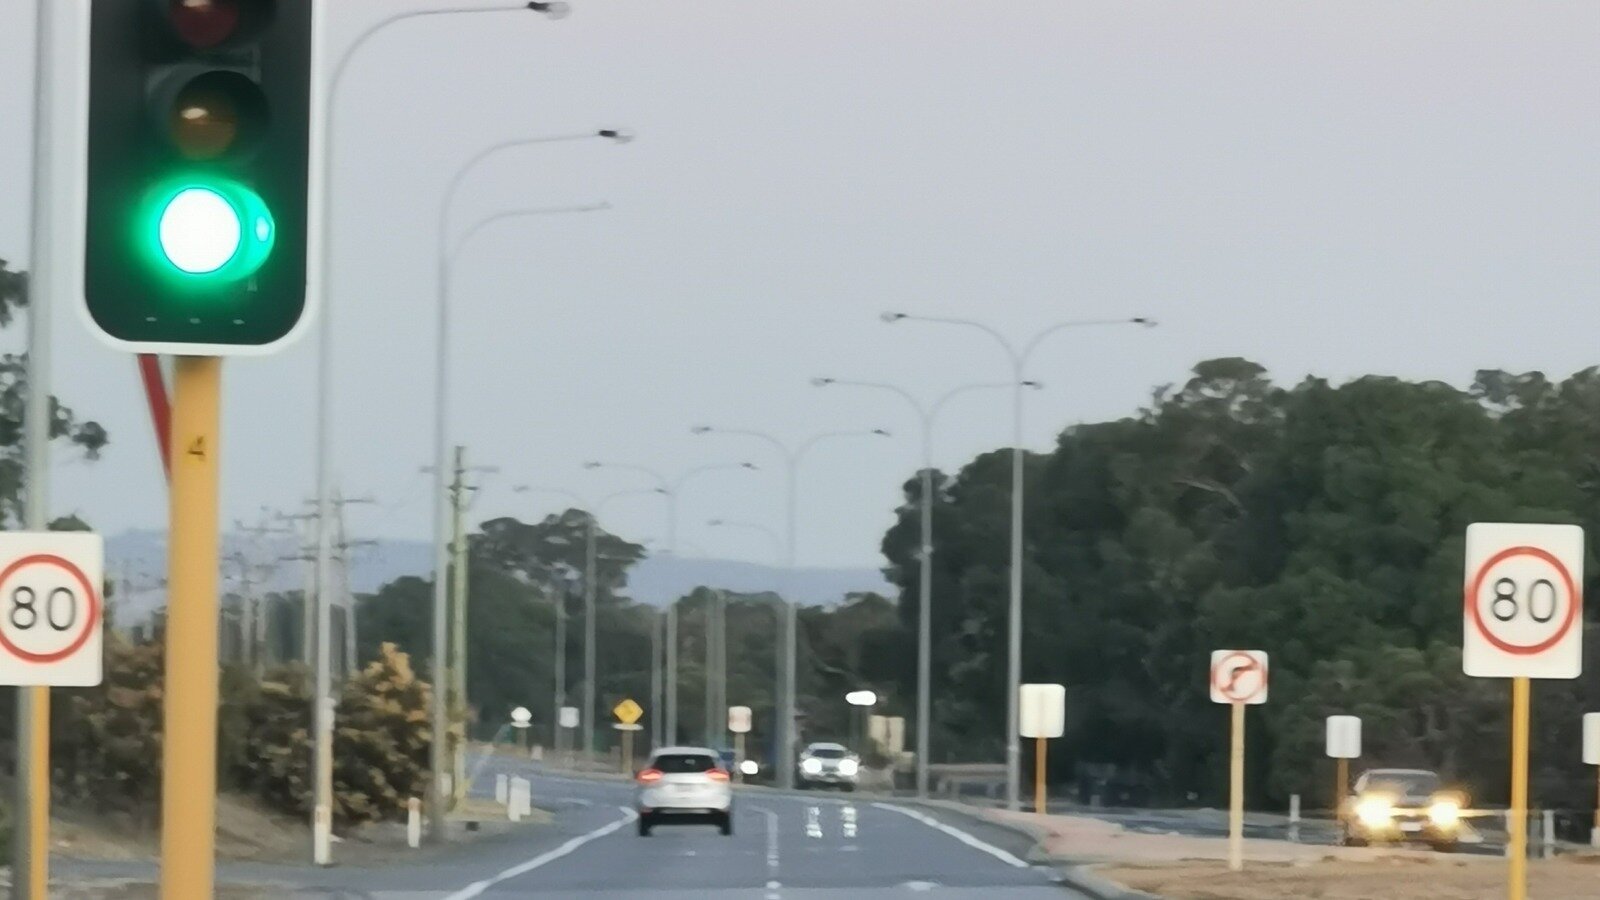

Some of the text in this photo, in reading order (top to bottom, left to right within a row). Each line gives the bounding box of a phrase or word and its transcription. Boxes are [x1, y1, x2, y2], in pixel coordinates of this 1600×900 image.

[187, 435, 206, 461] 4
[10, 586, 76, 631] 80
[1492, 577, 1556, 623] 80
